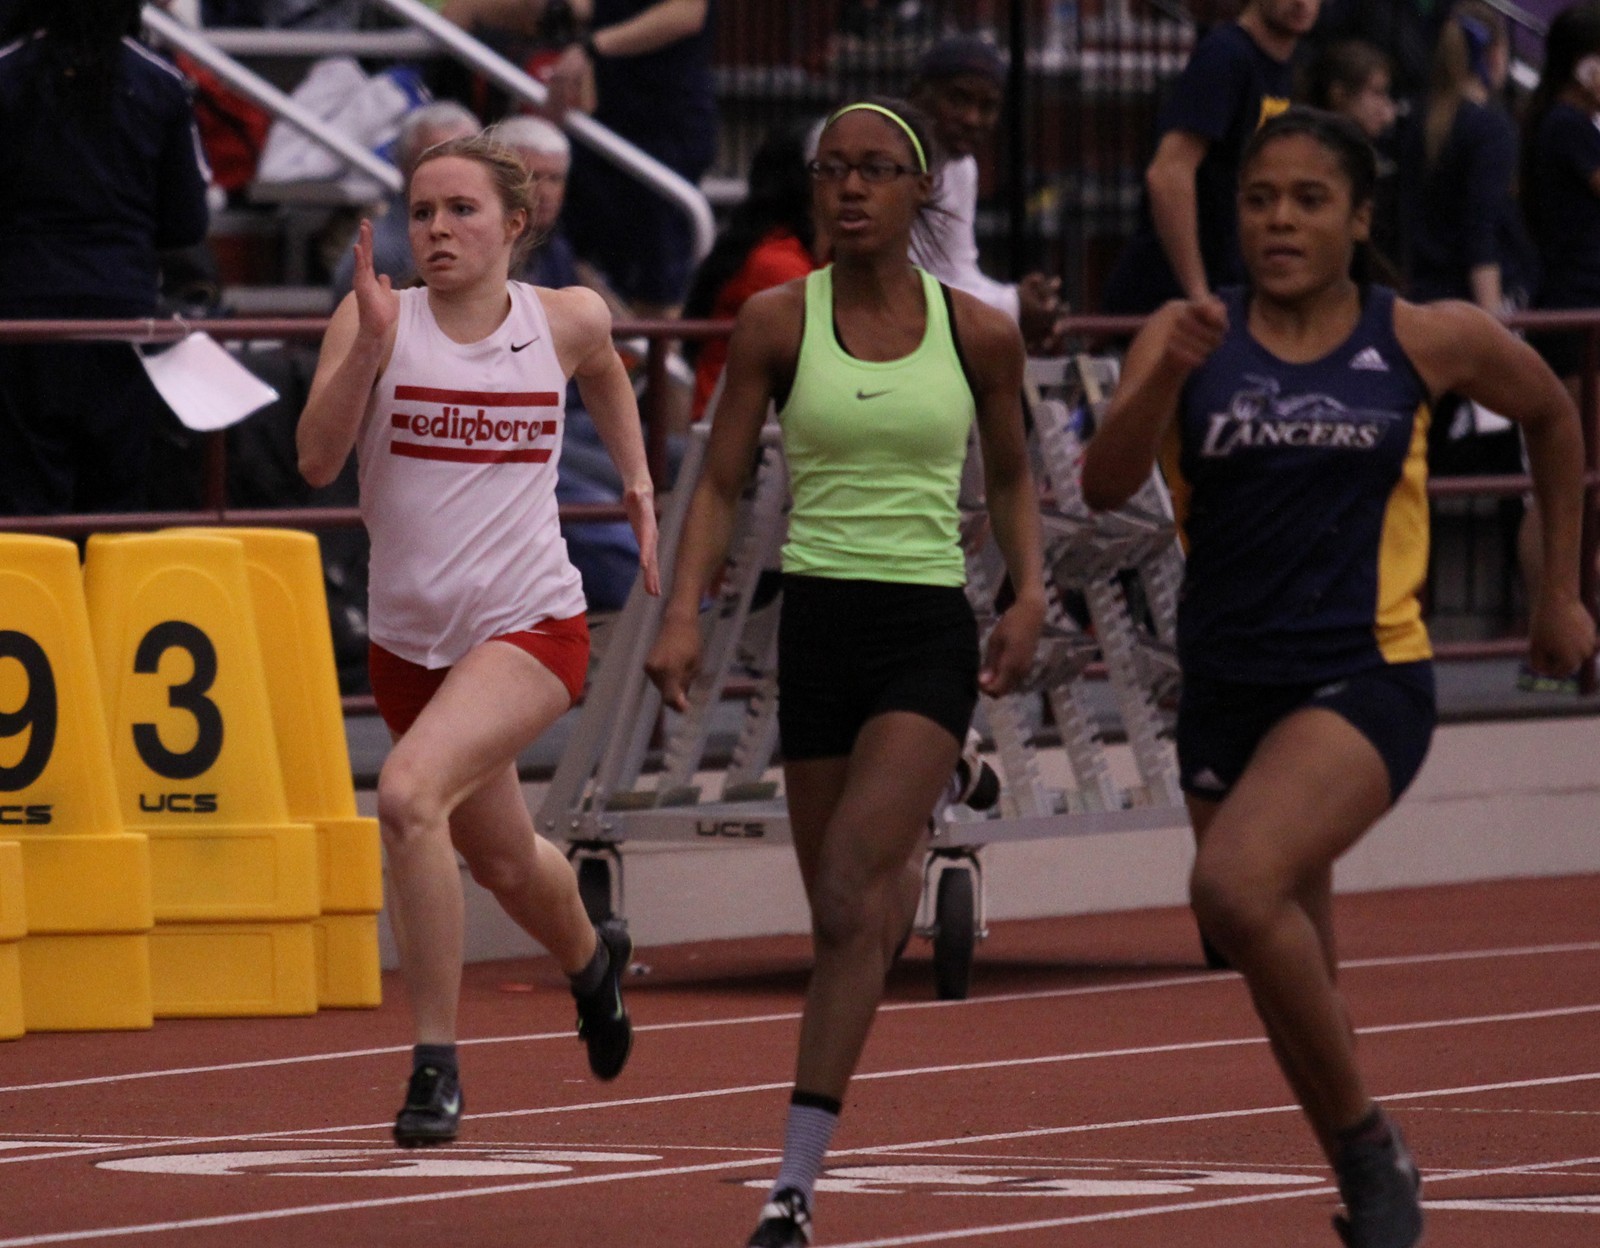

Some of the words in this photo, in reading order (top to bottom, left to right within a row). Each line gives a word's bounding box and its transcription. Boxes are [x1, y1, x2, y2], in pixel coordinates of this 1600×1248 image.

[411, 406, 542, 446] edinboro
[1201, 411, 1379, 457] LANCERS
[0, 630, 58, 793] 9
[131, 620, 224, 780] 3
[139, 793, 218, 813] UCS
[696, 820, 764, 838] UCS
